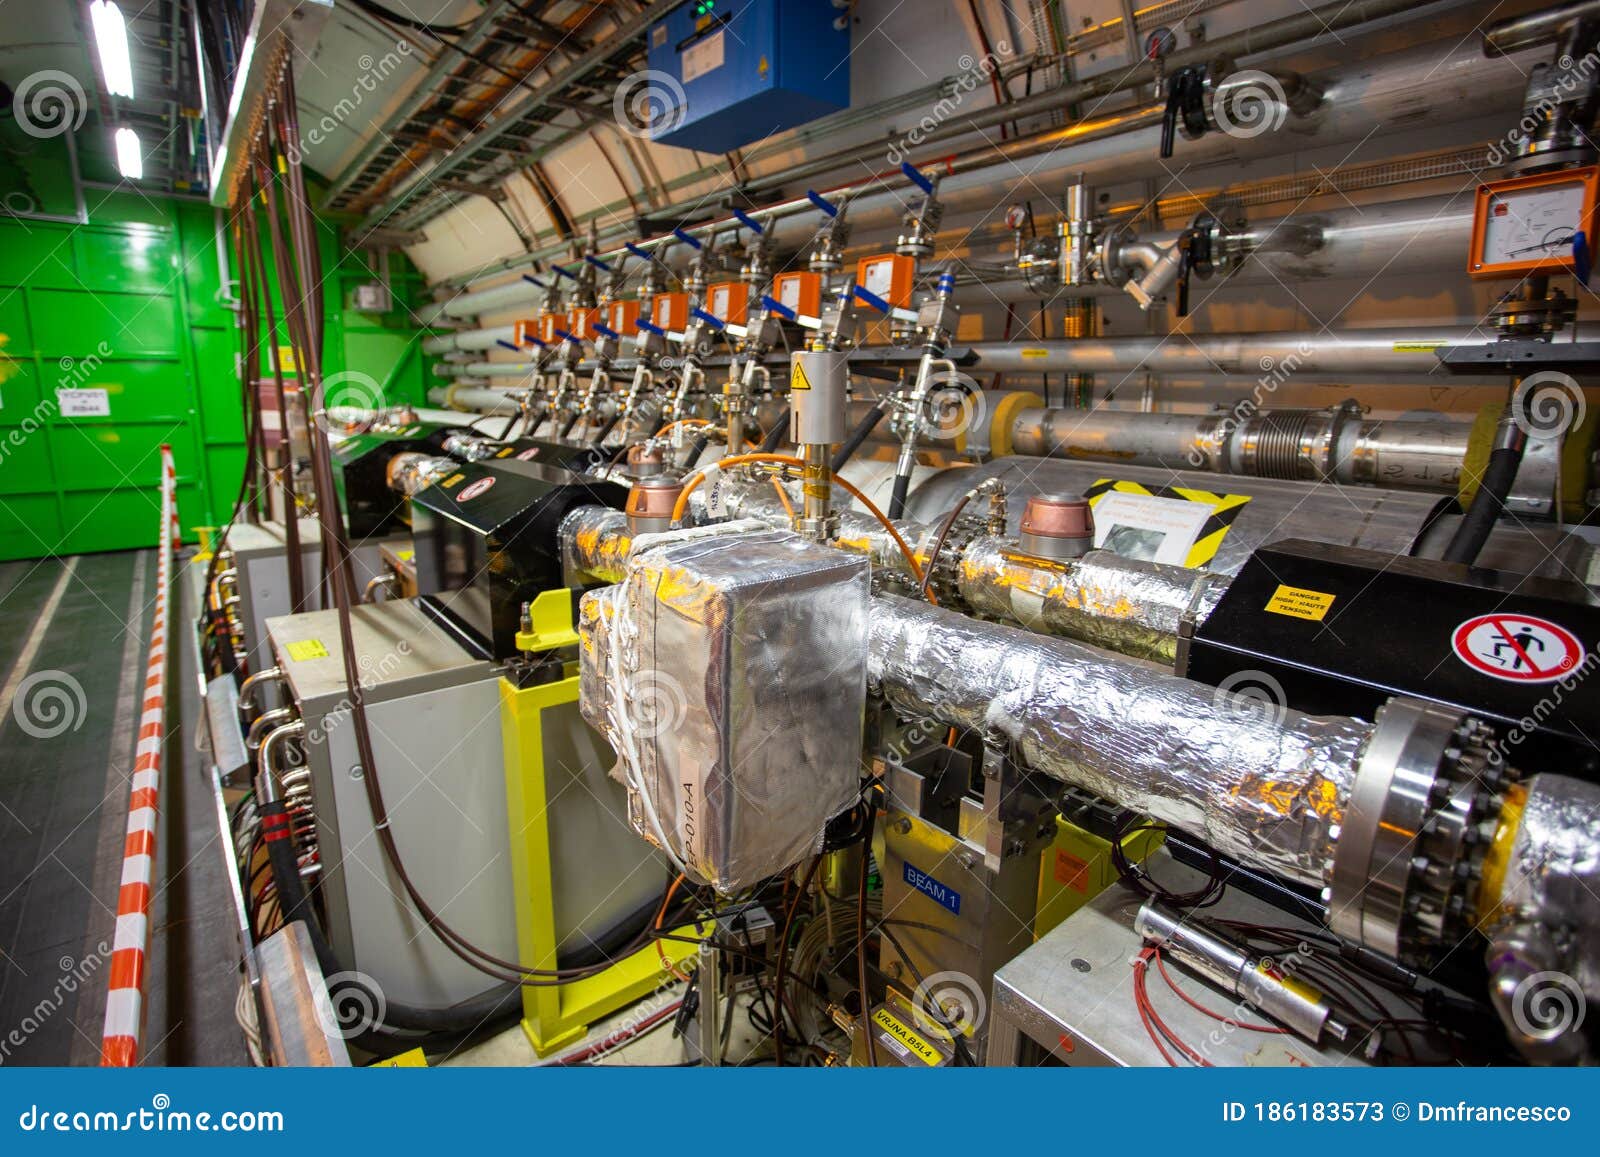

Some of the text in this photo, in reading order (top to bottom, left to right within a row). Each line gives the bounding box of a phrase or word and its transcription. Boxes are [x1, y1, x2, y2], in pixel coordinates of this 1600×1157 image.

[1289, 592, 1320, 601] DANGER
[1279, 605, 1312, 615] TENSION
[907, 868, 956, 908] BEAM 1
